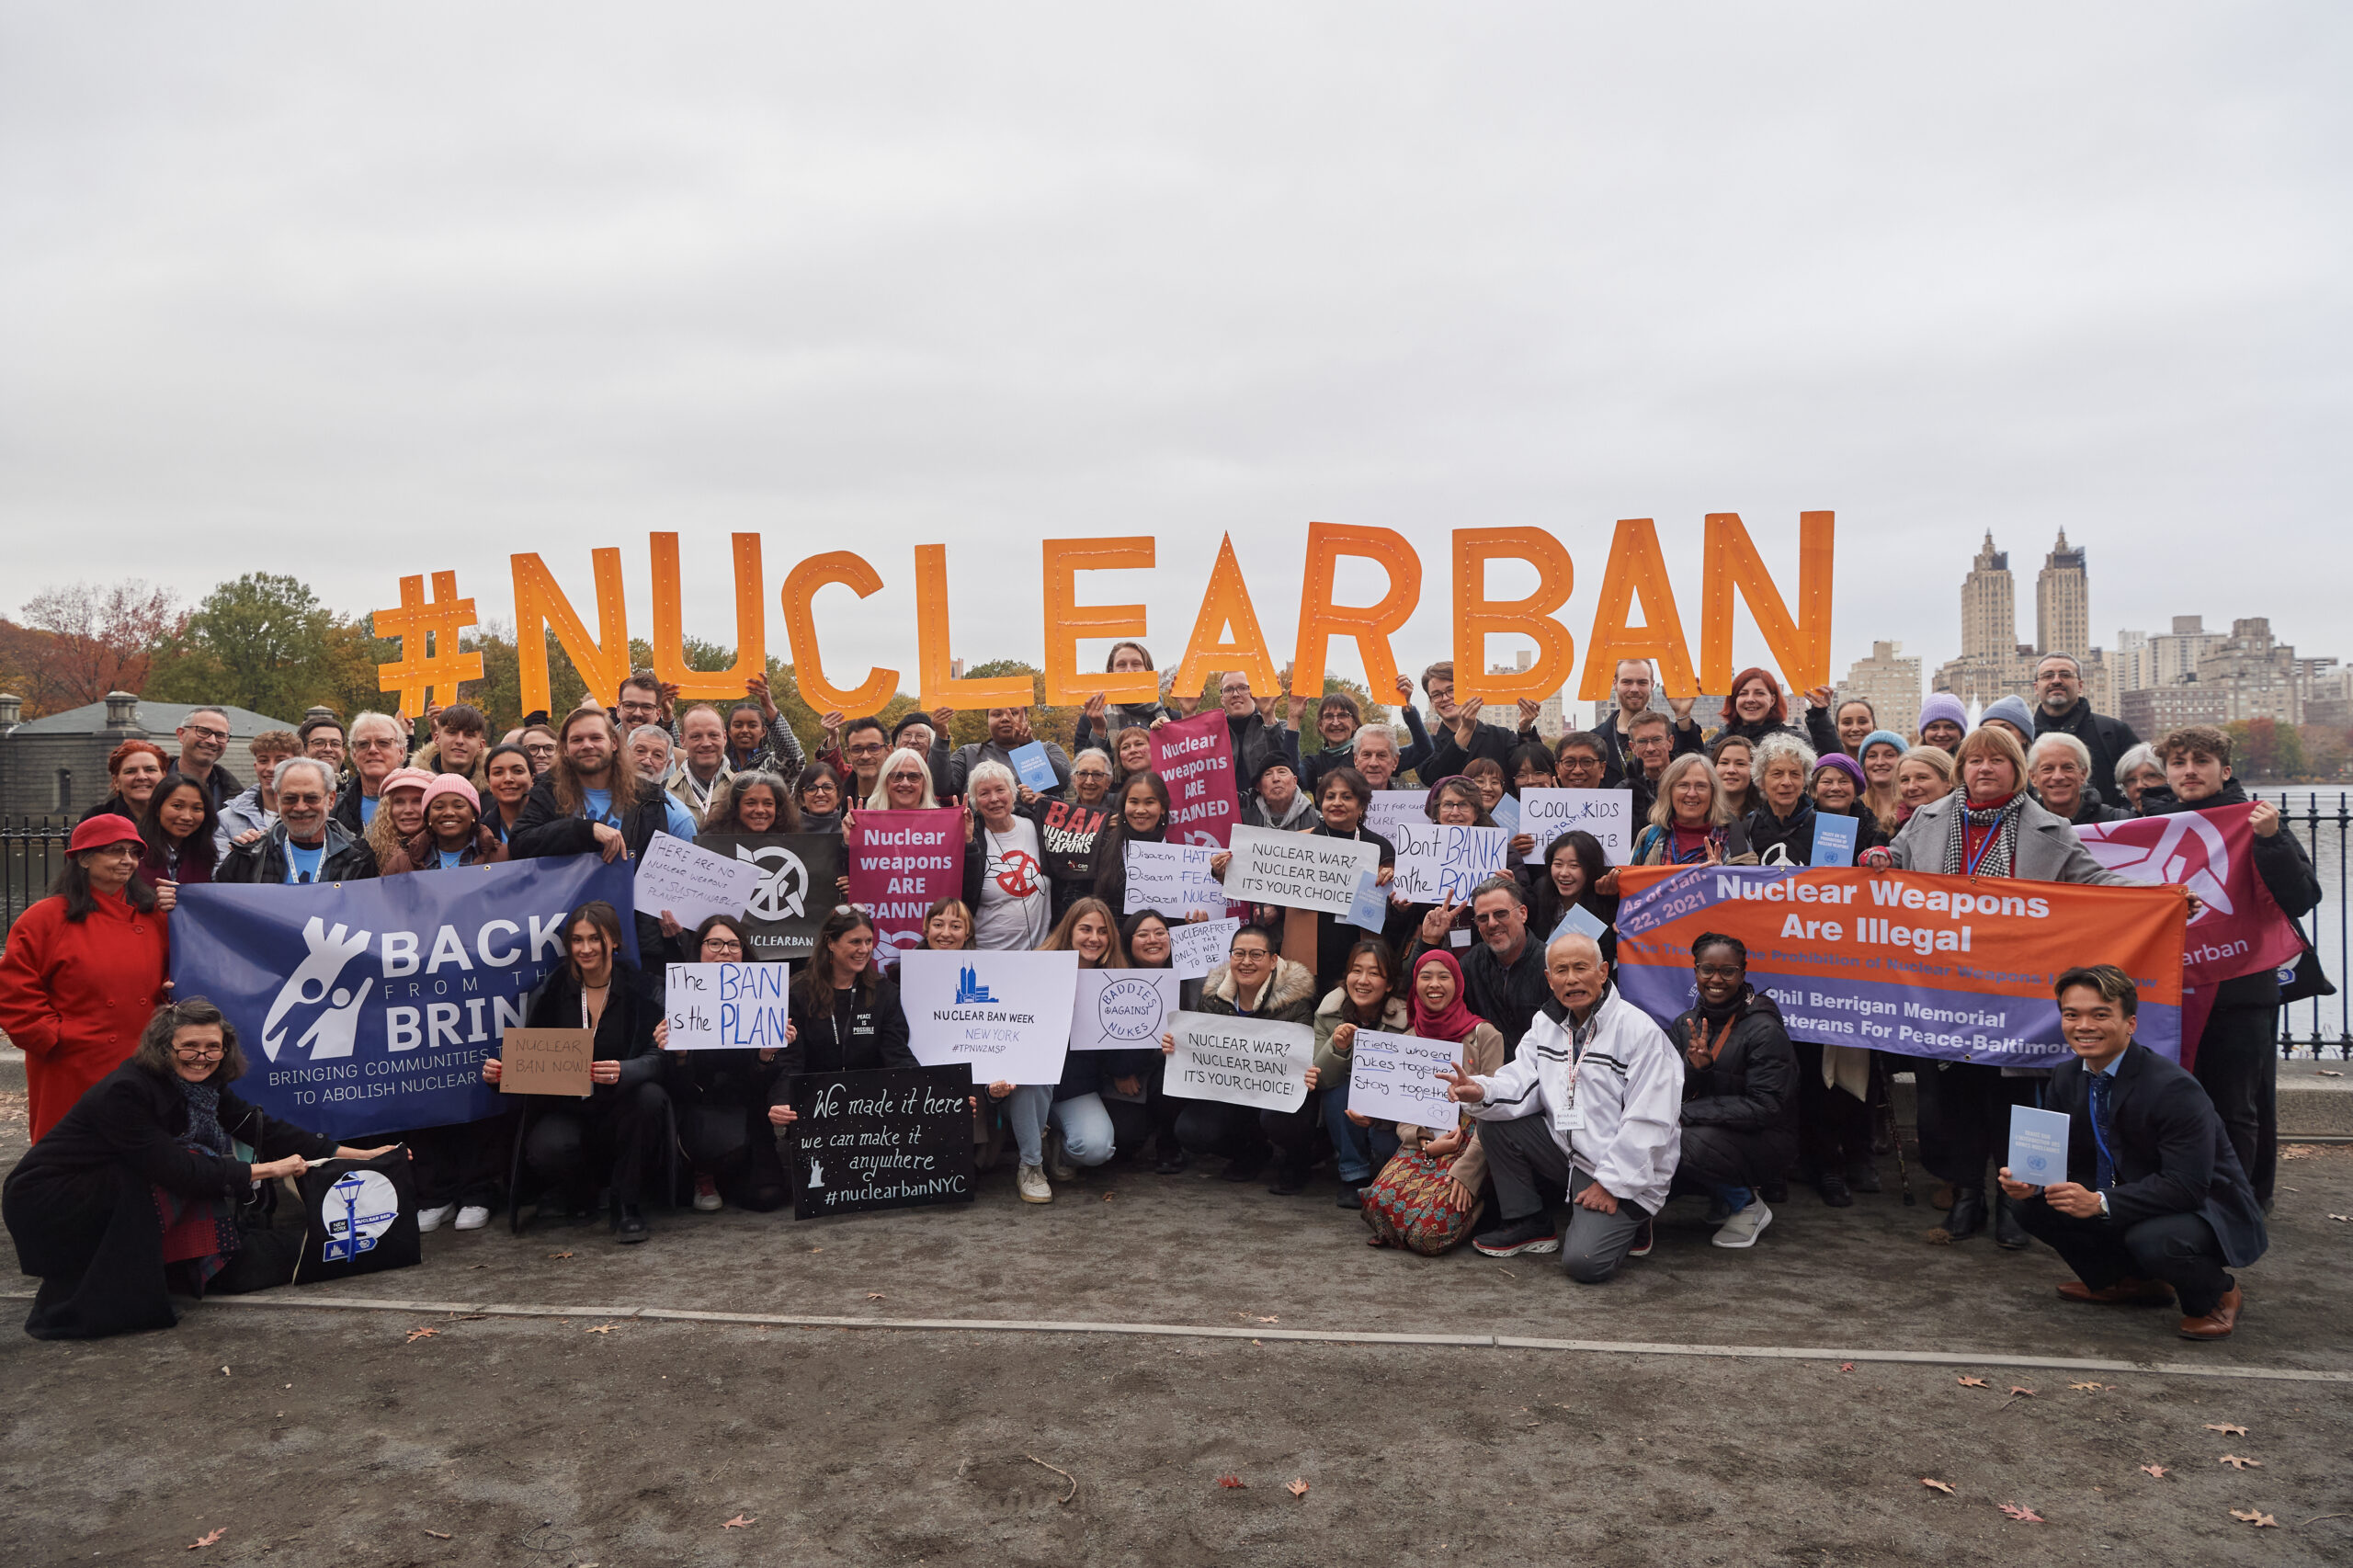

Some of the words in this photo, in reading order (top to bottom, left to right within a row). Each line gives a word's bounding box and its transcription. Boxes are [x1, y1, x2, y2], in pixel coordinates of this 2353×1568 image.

[1162, 734, 1218, 760] Nuclear
[1161, 756, 1228, 782] weapons
[1185, 779, 1206, 800] ARE
[1044, 801, 1108, 835] BAN
[1369, 802, 1389, 812] NEY
[1392, 802, 1406, 812] FOR
[1529, 800, 1576, 819] COOL
[1043, 824, 1097, 844] NUCLEAR
[1365, 816, 1396, 826] TURE
[864, 828, 946, 846] Nuclear
[1045, 837, 1092, 854] EAPONS
[1397, 824, 1442, 858] Don't
[1440, 826, 1506, 871] BANK
[1594, 834, 1619, 846] MB
[651, 835, 691, 863] THERE
[693, 858, 715, 871] ARE
[718, 867, 735, 879] NO
[860, 856, 952, 874] weapons
[1128, 844, 1176, 861] Disarm
[1252, 843, 1315, 864] NUCLEAR
[1319, 851, 1358, 869] WAR?
[647, 859, 688, 876] NUCLEAR
[1252, 860, 1316, 882] NUCLEAR
[1319, 870, 1352, 886] BAN!
[647, 886, 685, 904] PLANET
[666, 881, 742, 908] SUSTAINABLE
[887, 877, 926, 894] ARE
[1242, 878, 1263, 891] IT'S
[1267, 881, 1302, 899] YOUR
[1434, 868, 1497, 902] BOM
[1622, 898, 1642, 915] As
[1645, 885, 1663, 903] of
[1668, 869, 1708, 893] Jan.
[1716, 874, 1858, 905] Nuclear
[1869, 880, 2050, 920] Weapons
[864, 902, 935, 919] BANNE
[1630, 912, 1662, 932] 22,
[1662, 890, 1708, 919] 2021
[381, 912, 568, 979] BACK
[1780, 913, 1844, 941] Are
[1857, 917, 1972, 956] Illegal
[1174, 948, 1198, 963] ONLY
[1202, 942, 1221, 952] WAY
[1187, 959, 1200, 969] TO
[1206, 954, 1221, 963] BE
[1631, 941, 1659, 954] The
[1662, 943, 1692, 956] Trea
[1745, 949, 1767, 960] he
[1771, 949, 1860, 968] Prohibition
[1865, 957, 1881, 970] of
[1887, 959, 1951, 977] Nuclear
[1957, 965, 2041, 984] Weapons
[385, 977, 479, 999] FROM
[512, 968, 547, 986] TH
[668, 966, 707, 991] The
[720, 963, 781, 1001] BAN
[1102, 983, 1157, 1008] BADDIES
[385, 992, 529, 1052] BRIN
[933, 1010, 984, 1021] NUCLEAR
[987, 1011, 1006, 1022] BAN
[1009, 1013, 1035, 1024] WEEK
[1110, 1006, 1150, 1016] AGAINST
[1810, 992, 1897, 1016] Berrigan
[1904, 1001, 2006, 1028] Memorial
[666, 1011, 685, 1031] is
[688, 1006, 712, 1031] the
[721, 1003, 785, 1046] PLAN
[965, 1028, 992, 1040] NEW
[994, 1028, 1021, 1042] YORK
[1108, 1022, 1149, 1037] NUKES
[1781, 1013, 1855, 1034] eterans
[1860, 1020, 1893, 1039] For
[516, 1038, 583, 1055] NUCLEAR
[1188, 1032, 1249, 1053] NUCLEAR
[1253, 1040, 1290, 1057] WAR?
[1354, 1031, 1399, 1053] Friends
[1405, 1047, 1429, 1058] who
[1430, 1051, 1452, 1061] end
[269, 1063, 358, 1086] BRINGING
[365, 1048, 490, 1076] COMMUNITIES
[516, 1059, 545, 1074] BAN
[552, 1059, 588, 1074] NOW!
[1192, 1051, 1253, 1073] NUCLEAR
[1255, 1060, 1288, 1076] BAN!
[294, 1090, 316, 1106] TO
[322, 1082, 395, 1103] ABOLISH
[402, 1071, 477, 1094] NUCLEAR
[1184, 1070, 1205, 1083] IT'S
[1208, 1073, 1244, 1090] YOUR
[1244, 1077, 1295, 1096] CHOICE!
[1354, 1075, 1390, 1095] Stay
[1399, 1083, 1449, 1101] togethe
[813, 1083, 847, 1119] We
[847, 1088, 894, 1118] made
[901, 1087, 918, 1115] it
[923, 1085, 963, 1115] here
[801, 1136, 824, 1149] we
[829, 1133, 855, 1146] can
[858, 1125, 901, 1147] make
[908, 1124, 922, 1145] it
[849, 1148, 936, 1182] anywhere
[824, 1175, 967, 1206] #nuclearbanNYC
[354, 1216, 380, 1224] NUCLEAR
